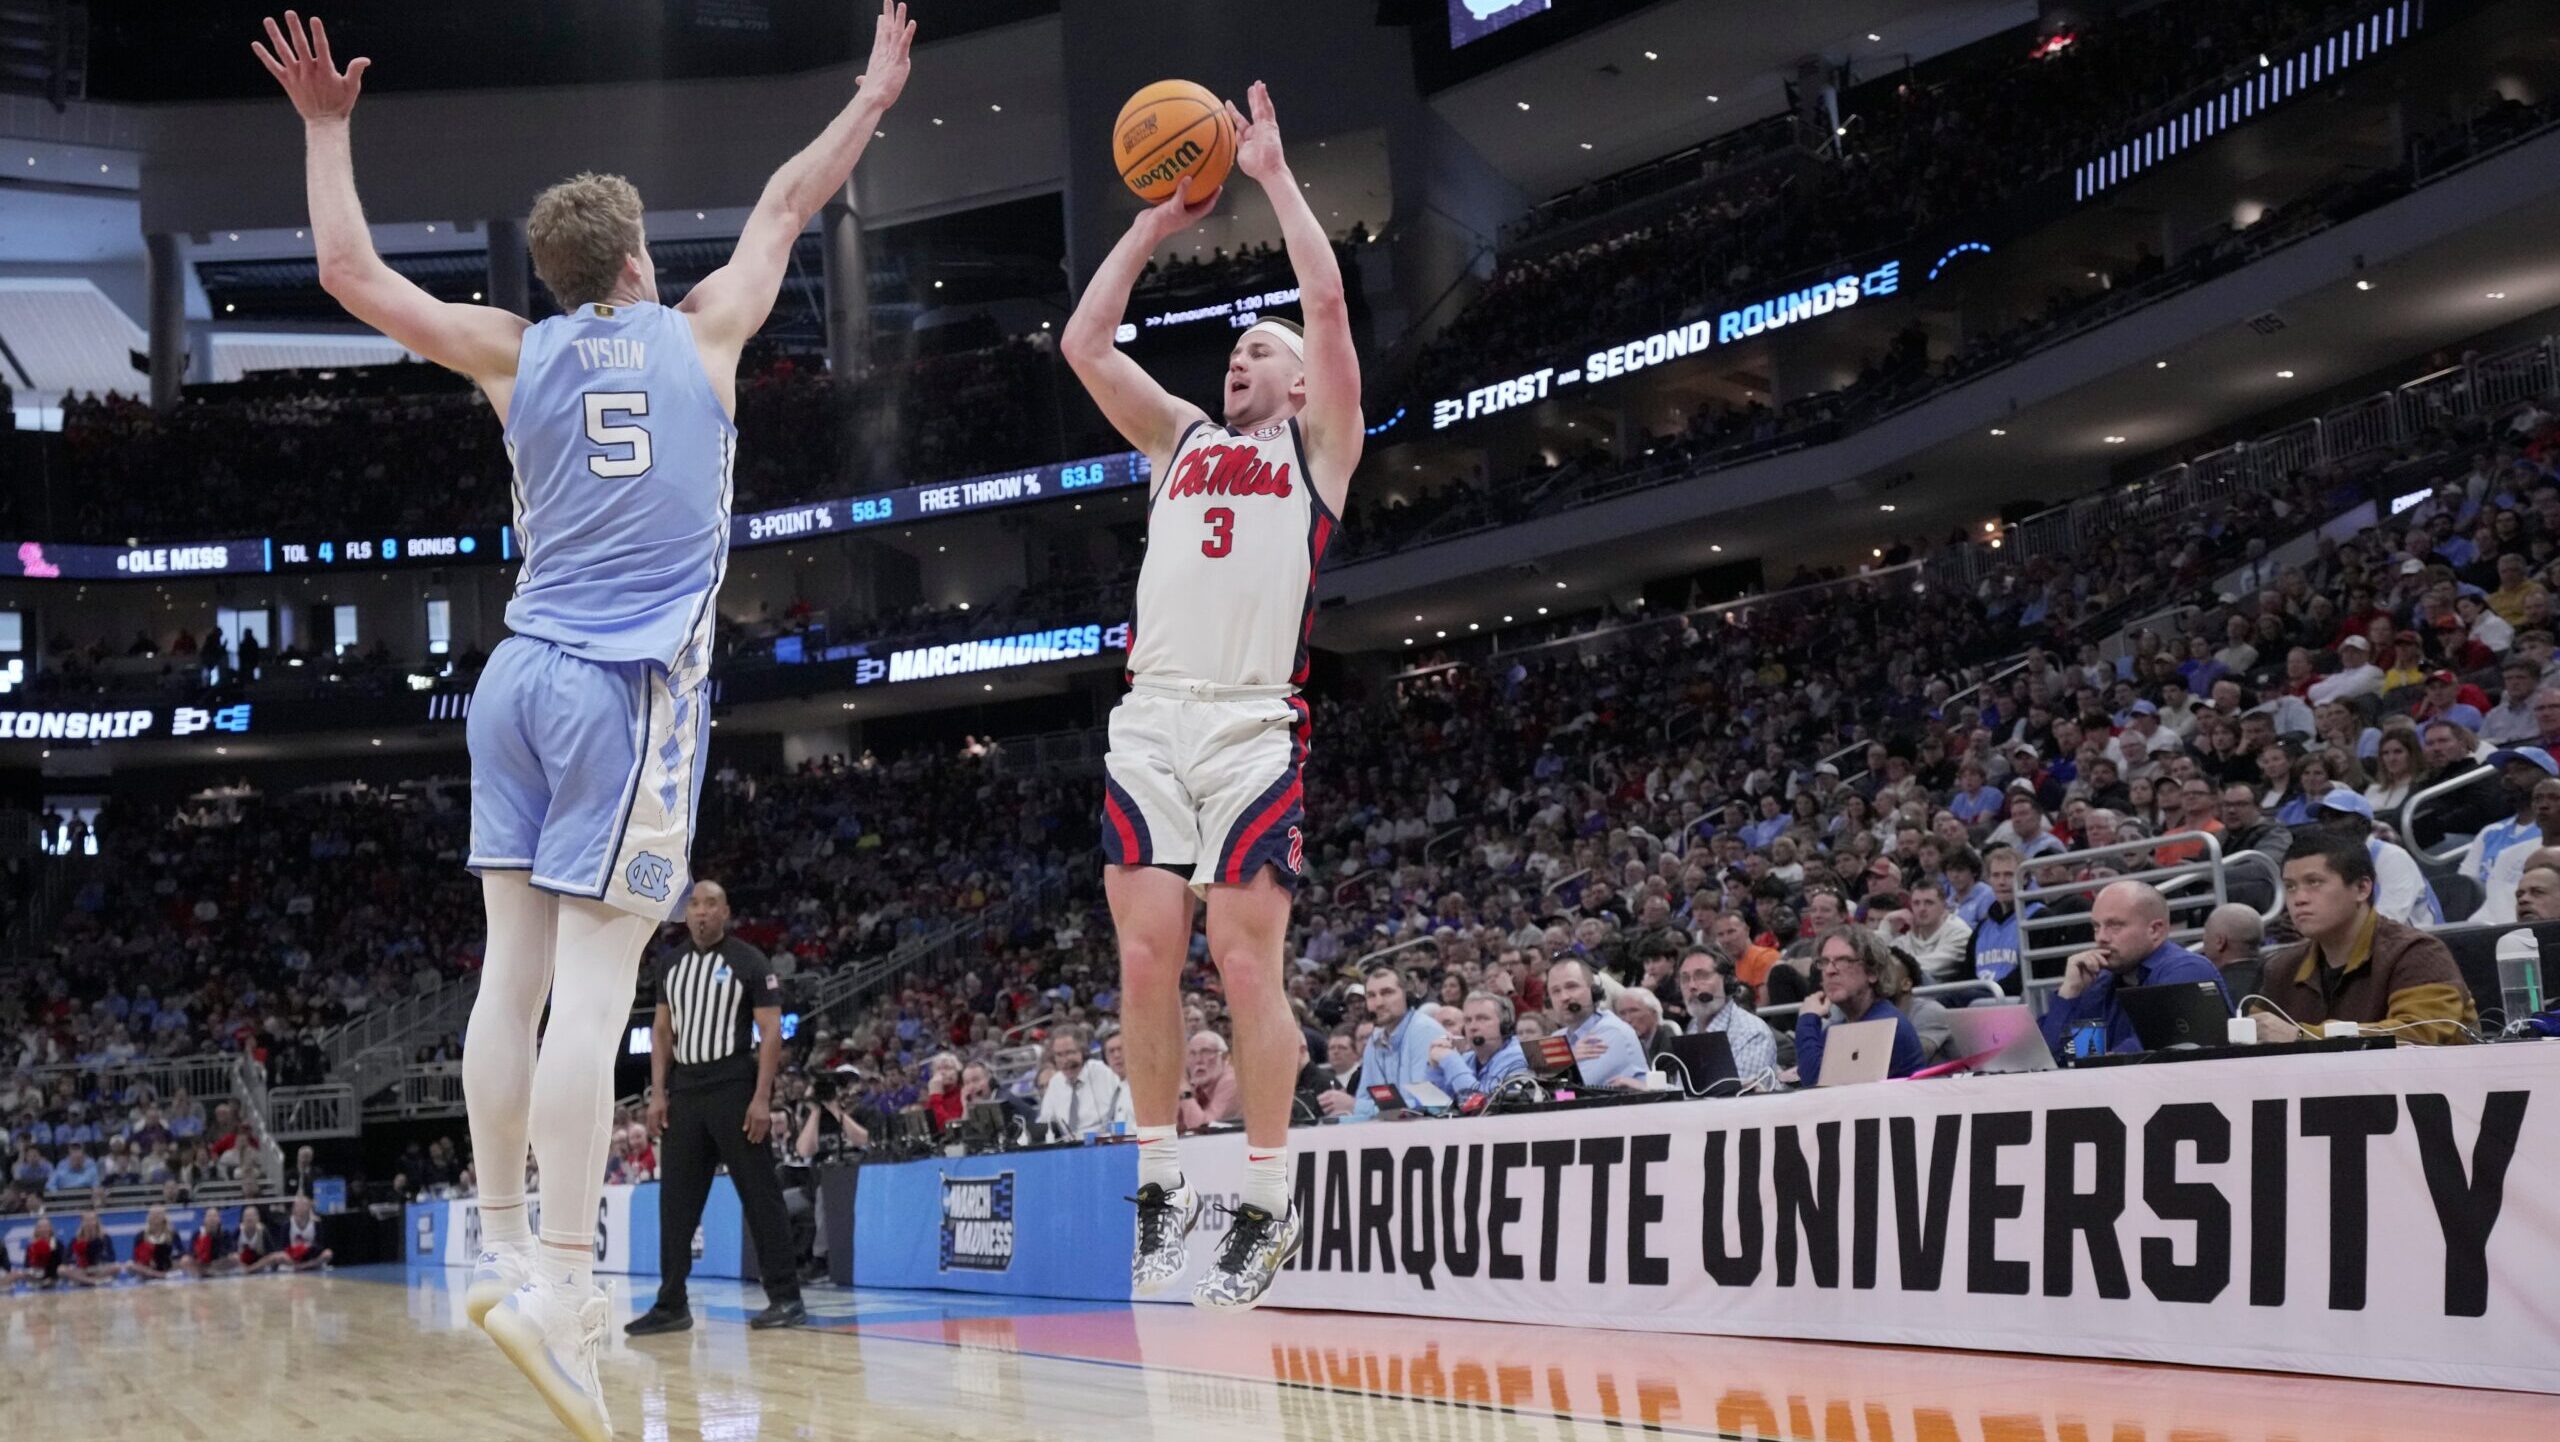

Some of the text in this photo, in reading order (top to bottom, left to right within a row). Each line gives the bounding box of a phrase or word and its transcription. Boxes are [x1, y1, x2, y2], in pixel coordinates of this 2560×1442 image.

[1131, 140, 1204, 189] Wilson
[1228, 312, 1258, 329] 1:00
[1234, 295, 1262, 313] 1:00
[571, 337, 645, 371] TYSON
[1466, 368, 1554, 420] FIRST
[1586, 320, 1711, 383] SECOND
[1718, 275, 1860, 343] ROUNDS
[582, 391, 653, 479] 5
[1256, 425, 1281, 438] SEC
[1168, 444, 1293, 500] Ole Miss
[749, 463, 1104, 539] 3-POINT % 58.3 FREE THROW % 63.6
[282, 544, 309, 563] TOL
[318, 543, 334, 562] 4
[345, 541, 373, 560] FLS
[407, 537, 457, 557] BONUS
[1201, 507, 1235, 558] 3
[128, 549, 168, 572] OLE
[170, 547, 228, 571] MISS
[888, 625, 1100, 682] MARCHMADNESS
[949, 1184, 992, 1219] MARCH
[1702, 1090, 2531, 1318] UNIVERSITY
[954, 1221, 1013, 1256] MADNESS
